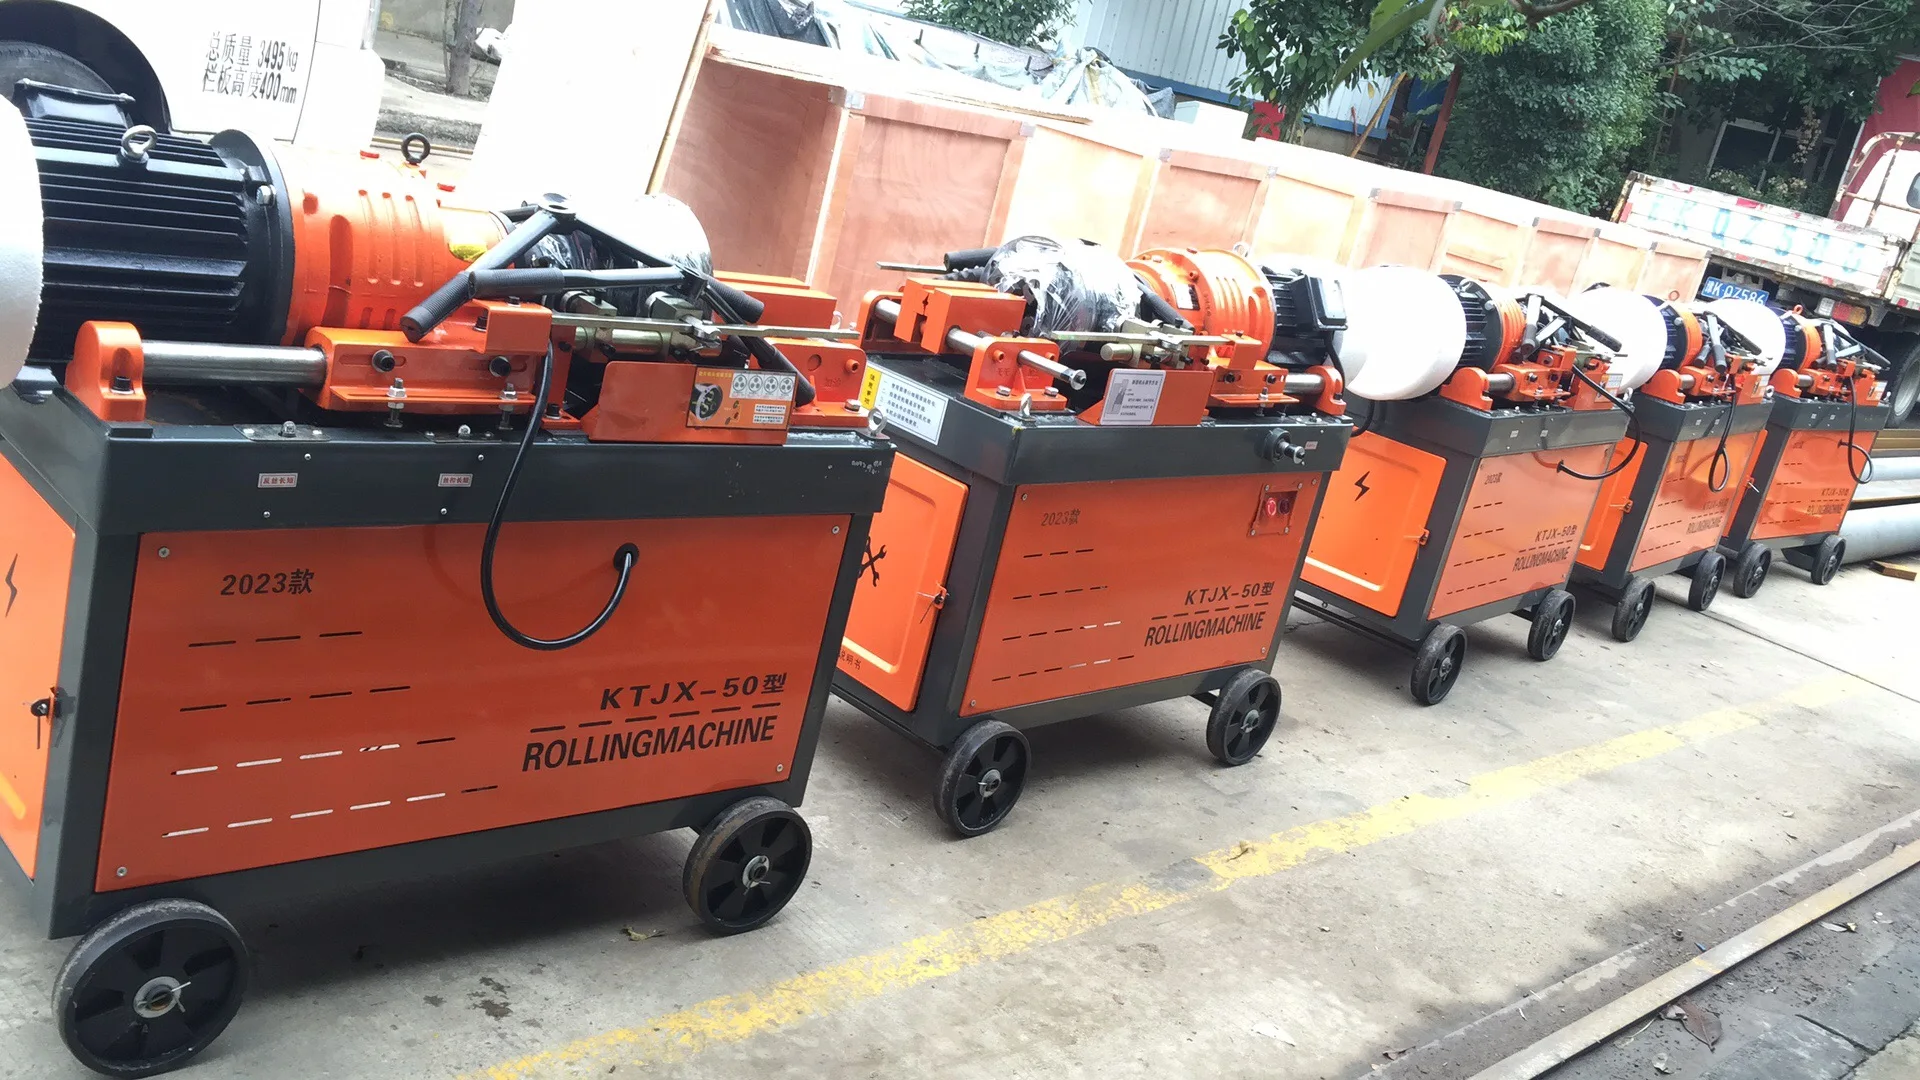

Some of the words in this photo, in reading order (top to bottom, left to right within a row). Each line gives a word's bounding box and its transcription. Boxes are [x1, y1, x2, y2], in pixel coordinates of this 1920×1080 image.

[206, 31, 253, 66] 总质量
[1041, 508, 1081, 526] 2023款
[220, 568, 315, 596] 2023款
[1184, 581, 1275, 606] KTJX-50型
[1144, 611, 1266, 647] ROLLINGMACHINE
[600, 672, 787, 710] KTJX-50型
[522, 715, 778, 772] ROLLINGMACHINE
